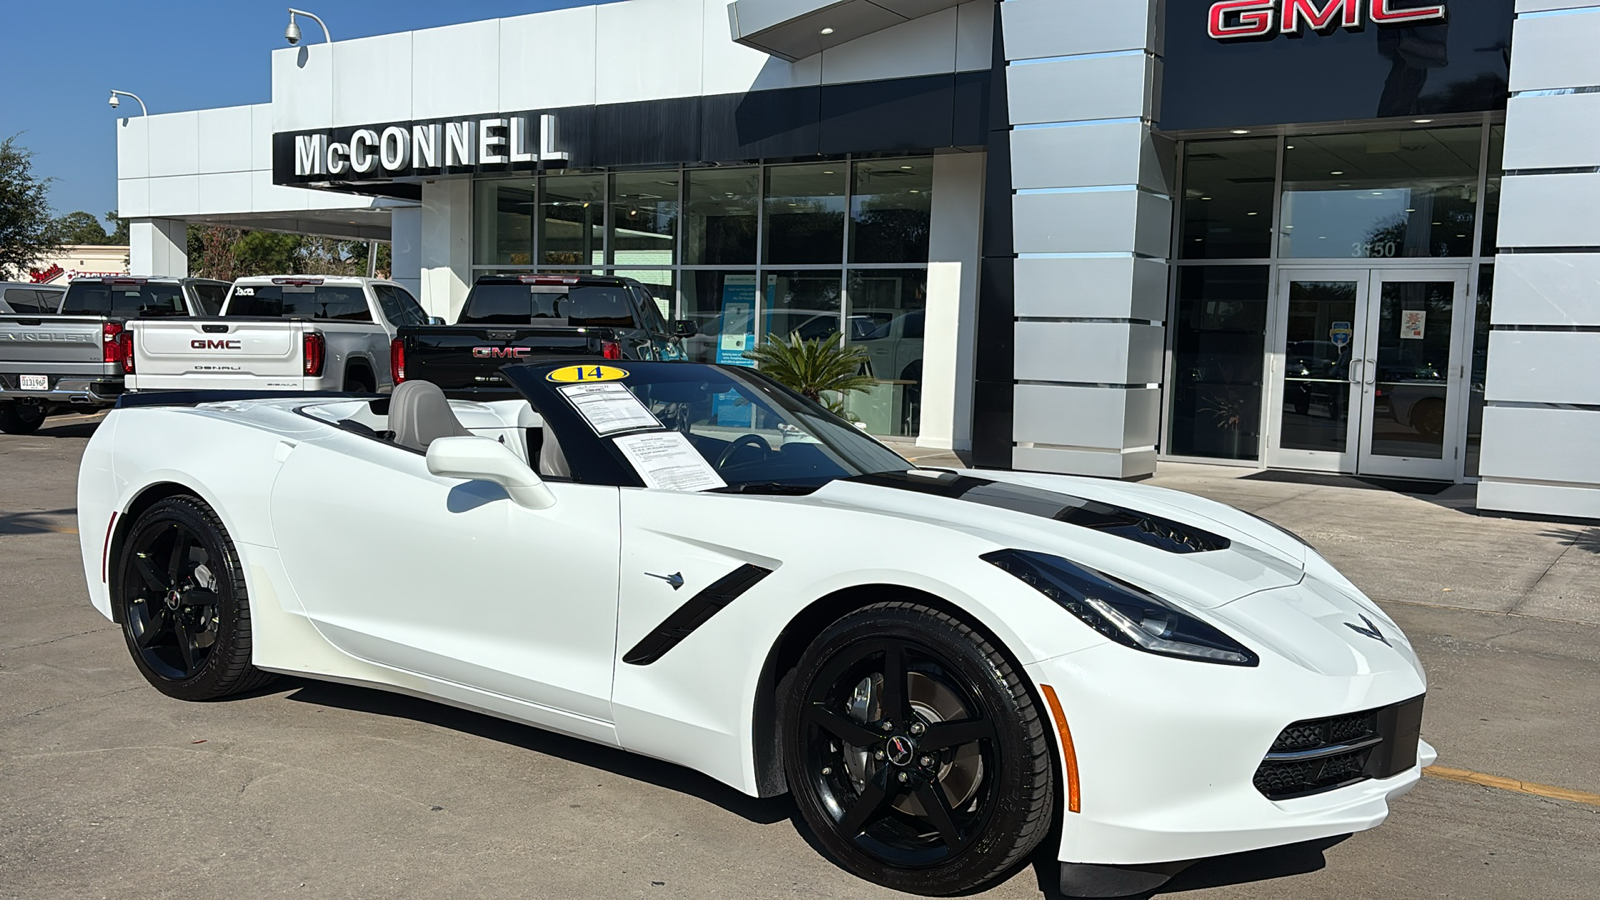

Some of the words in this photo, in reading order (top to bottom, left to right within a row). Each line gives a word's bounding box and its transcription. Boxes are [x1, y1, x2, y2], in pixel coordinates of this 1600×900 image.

[294, 114, 568, 176] McCONNELL
[0, 332, 92, 342] EVROLET
[191, 339, 242, 349] GMC
[472, 347, 531, 358] GMC
[573, 366, 604, 381] 14
